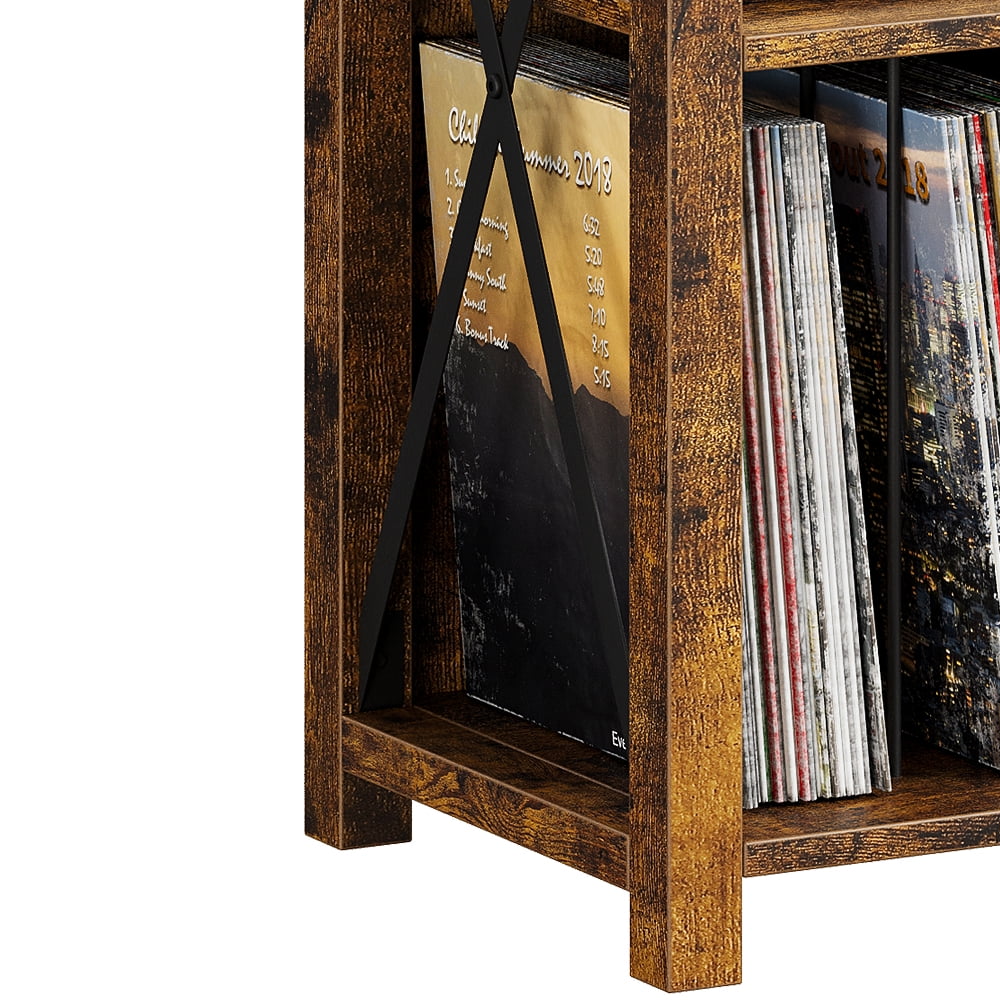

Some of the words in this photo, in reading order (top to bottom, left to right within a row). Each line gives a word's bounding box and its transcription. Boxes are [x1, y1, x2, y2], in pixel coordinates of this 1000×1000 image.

[573, 150, 613, 195] 2018
[872, 147, 930, 204] 218
[583, 212, 601, 237] 6:32
[584, 244, 603, 267] 5:20
[485, 267, 507, 291] South
[586, 275, 605, 298] 5:48
[462, 288, 487, 314] Sunset
[588, 303, 606, 328] 7:10
[464, 318, 488, 344] Bonus
[487, 325, 509, 351] Track
[592, 334, 610, 358] 8:15
[593, 366, 612, 389] 5:15
